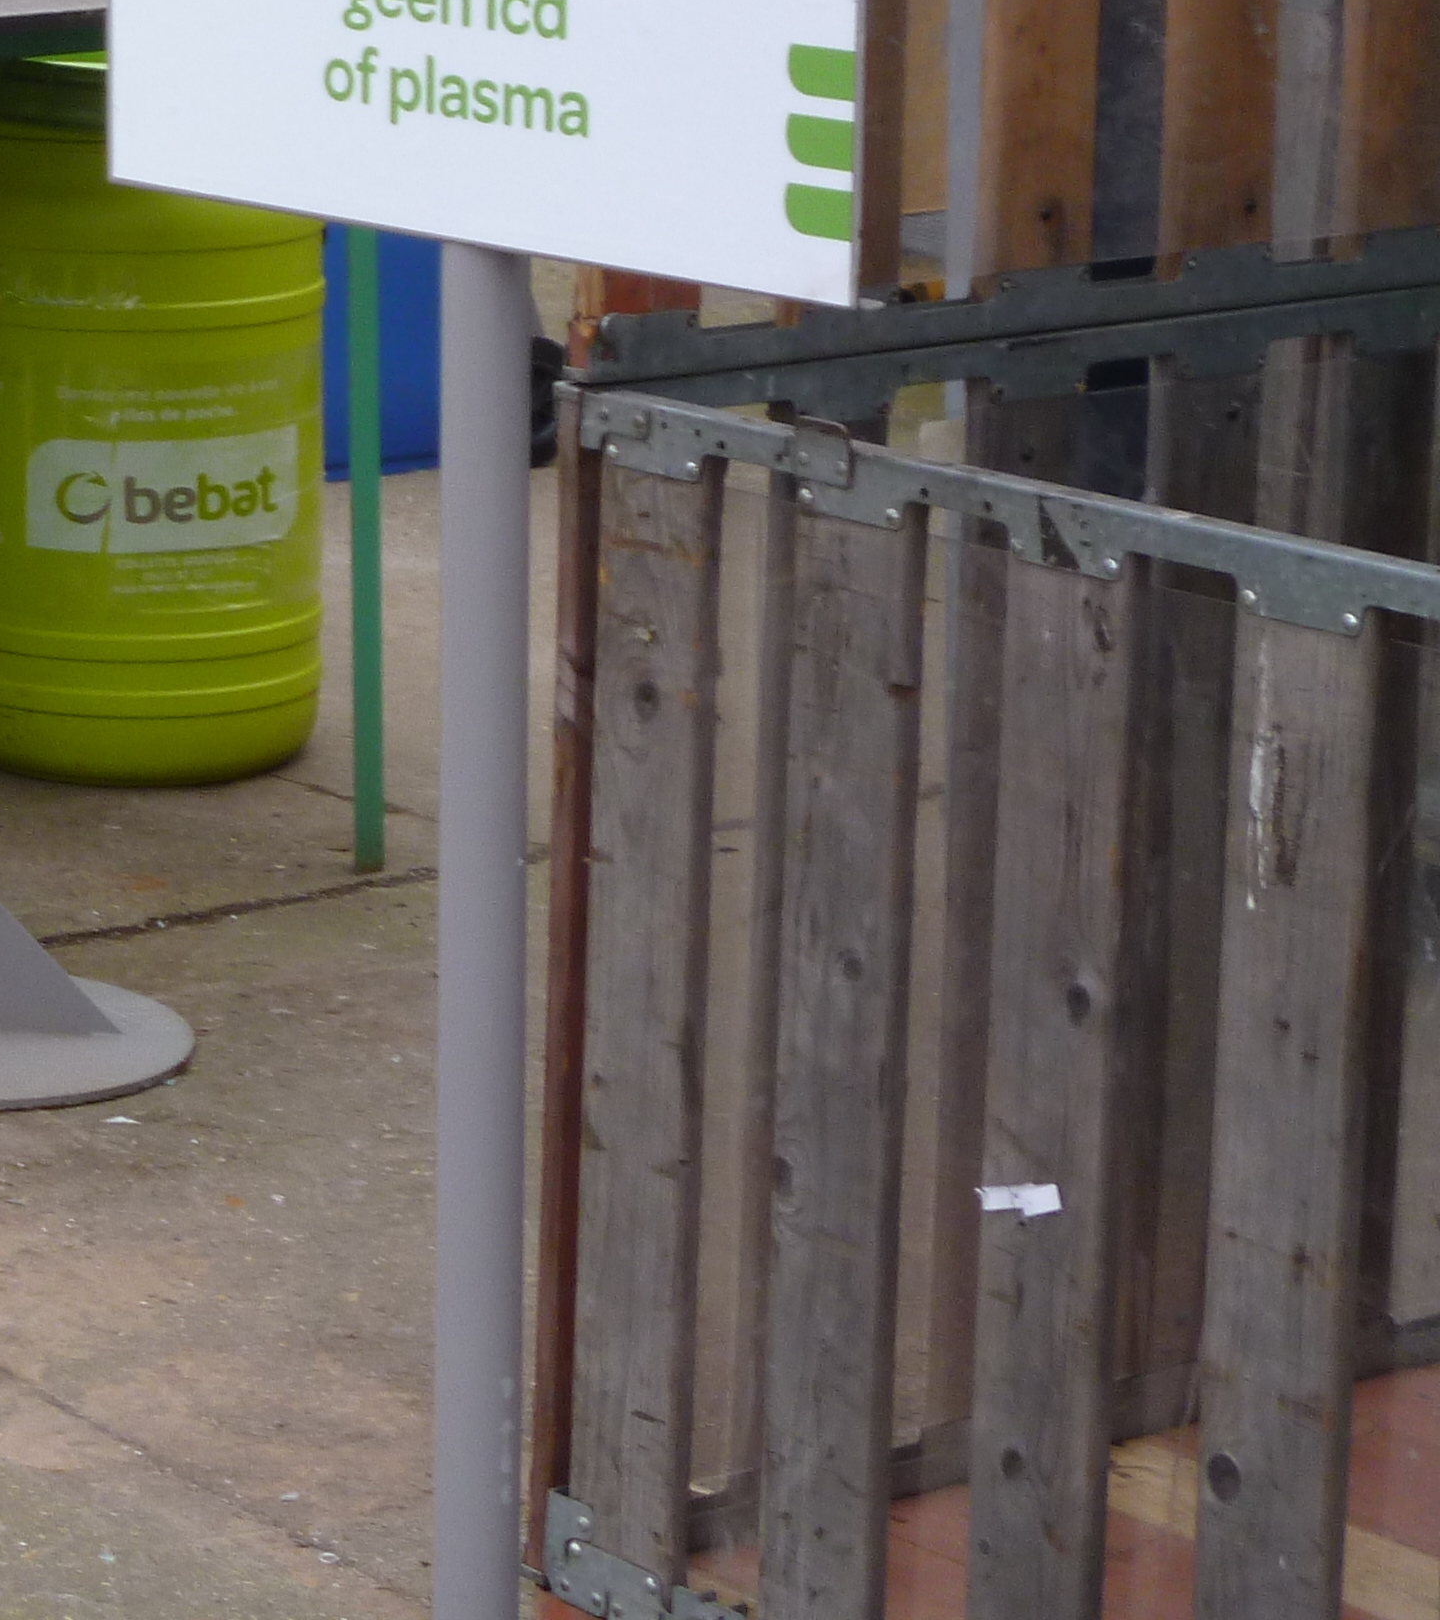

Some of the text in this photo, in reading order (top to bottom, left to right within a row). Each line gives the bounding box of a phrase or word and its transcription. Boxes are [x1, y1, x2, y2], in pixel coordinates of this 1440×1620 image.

[323, 47, 591, 139] of plasma
[122, 464, 279, 525] bebat
